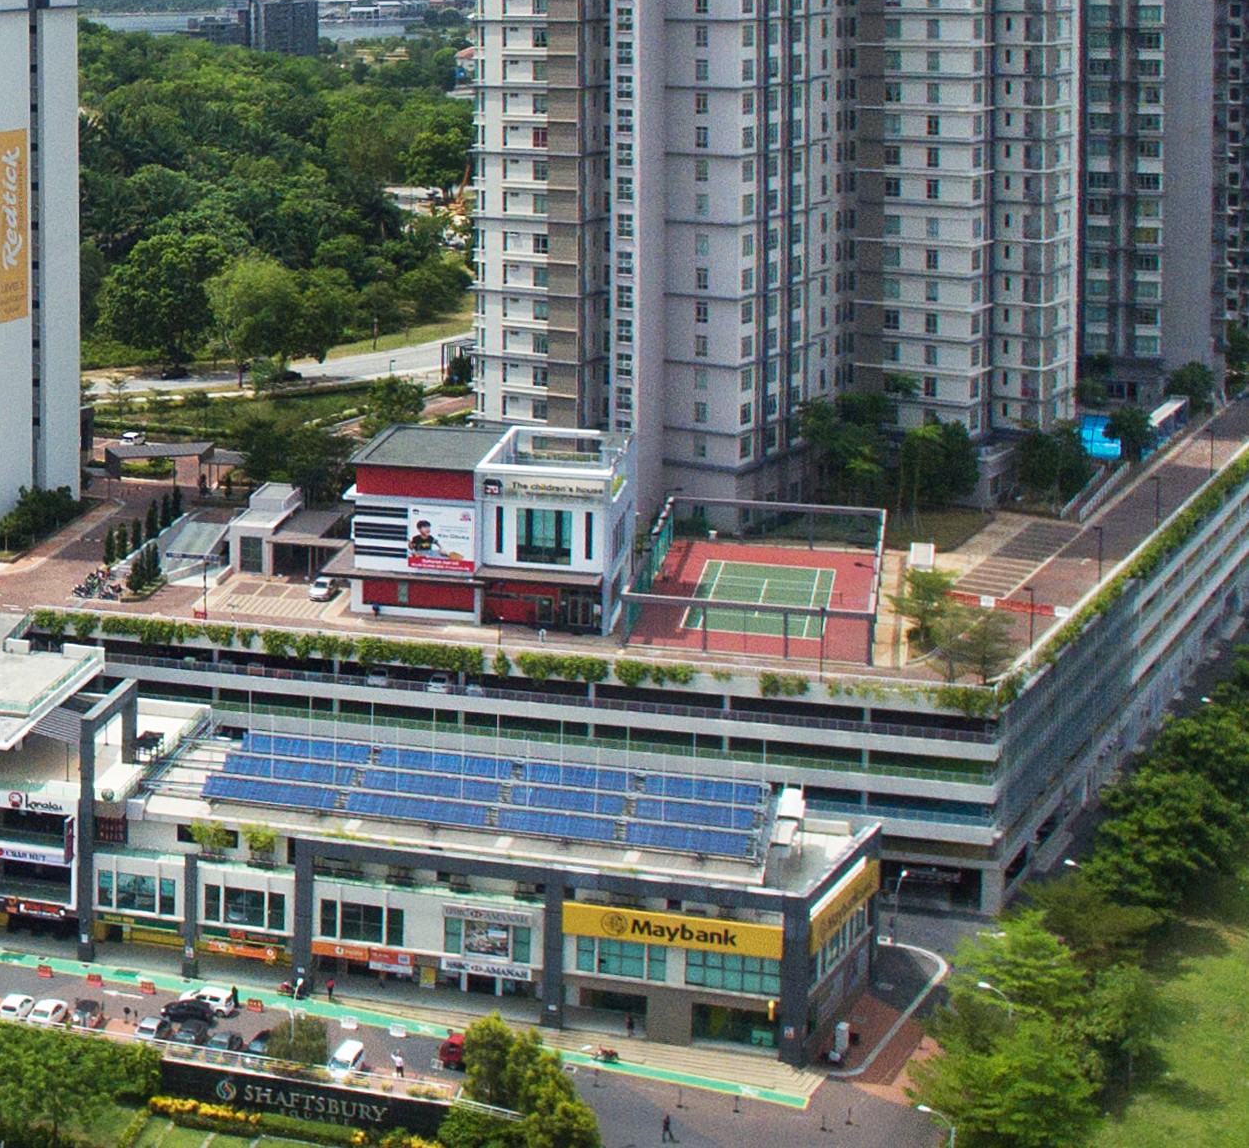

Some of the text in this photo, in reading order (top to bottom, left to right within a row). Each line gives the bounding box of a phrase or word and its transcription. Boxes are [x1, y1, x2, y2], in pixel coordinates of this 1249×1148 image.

[2, 146, 23, 271] Redtick
[512, 481, 528, 490] The
[575, 484, 603, 495] house
[630, 918, 737, 947] Maybank
[244, 1084, 388, 1122] SHAFTSBURY
